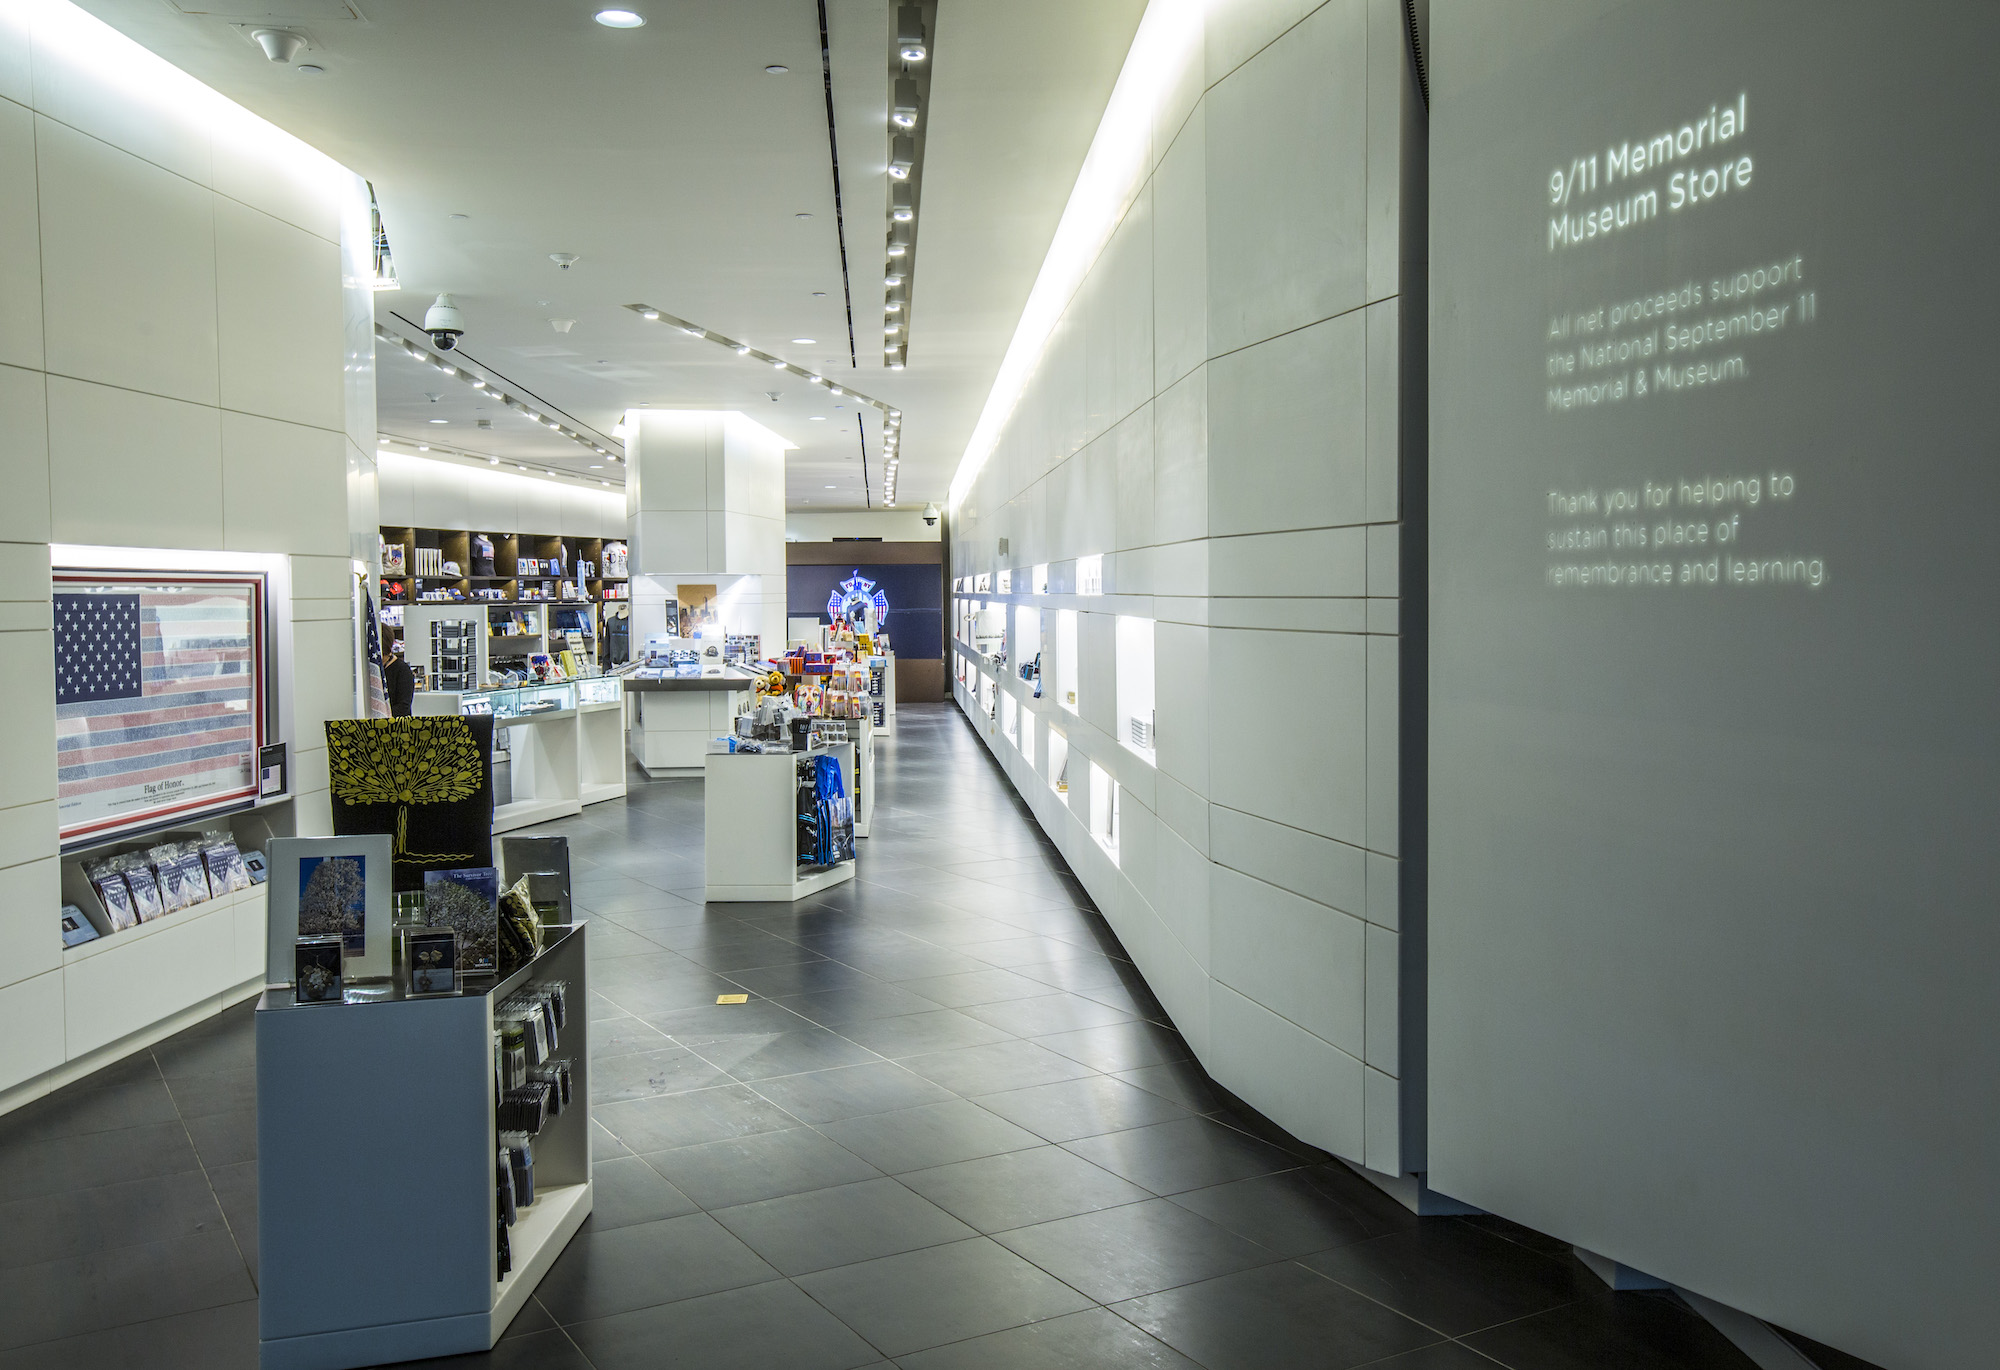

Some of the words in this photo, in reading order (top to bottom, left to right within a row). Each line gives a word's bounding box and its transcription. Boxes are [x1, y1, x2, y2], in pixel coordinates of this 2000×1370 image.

[1550, 155, 1597, 205] 9/11
[1607, 93, 1746, 183] Memorial
[1549, 189, 1657, 249] Museum
[1669, 155, 1753, 209] Store
[1548, 314, 1570, 340] All
[1574, 307, 1603, 334] net
[1610, 280, 1702, 330] proceeds
[1711, 254, 1802, 300] support
[1548, 354, 1576, 376] the
[1580, 329, 1658, 369] National
[1666, 304, 1790, 351] September
[1798, 292, 1815, 321] 11
[1548, 373, 1629, 412] Memorial
[1634, 369, 1648, 396] &
[1548, 489, 1598, 515] Thank
[1603, 490, 1638, 517] you
[1645, 481, 1672, 508] for
[1678, 477, 1760, 504] helping
[1770, 472, 1794, 498] to
[1548, 527, 1607, 549] sustain
[1612, 523, 1647, 547] this
[1653, 520, 1709, 549] place
[1716, 514, 1739, 541] of
[1548, 560, 1673, 585] remembrance
[1679, 556, 1719, 582] and
[144, 785, 157, 794] Flag
[157, 781, 163, 791] of
